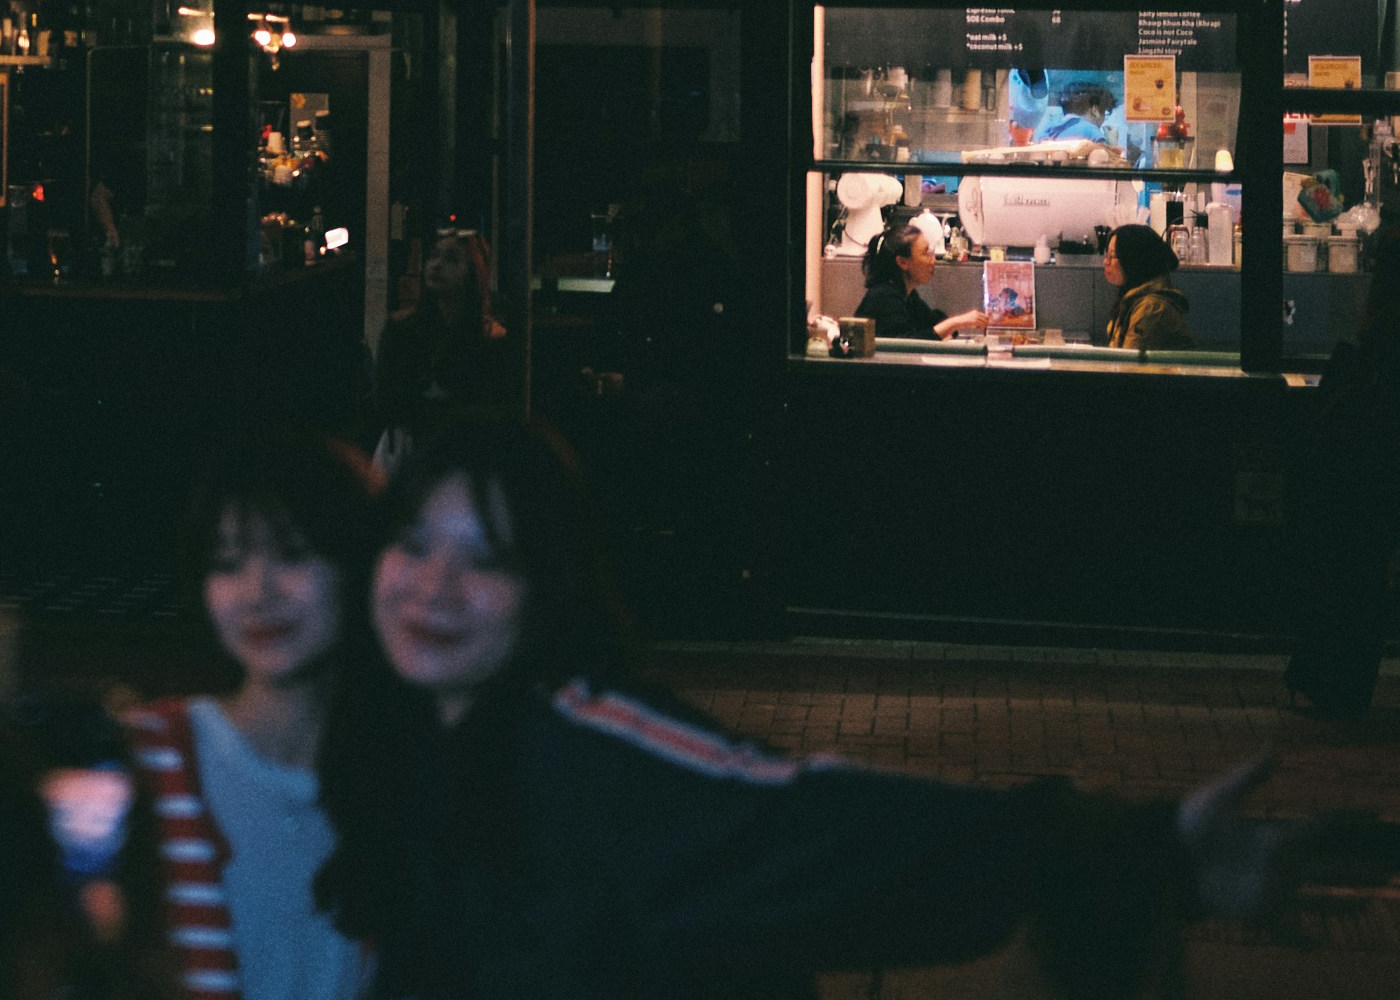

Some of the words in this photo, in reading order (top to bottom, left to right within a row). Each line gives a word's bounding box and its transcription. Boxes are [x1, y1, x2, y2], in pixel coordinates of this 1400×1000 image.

[1139, 28, 1155, 36] Coco
[1163, 28, 1175, 36] not
[1176, 28, 1193, 36] Coco
